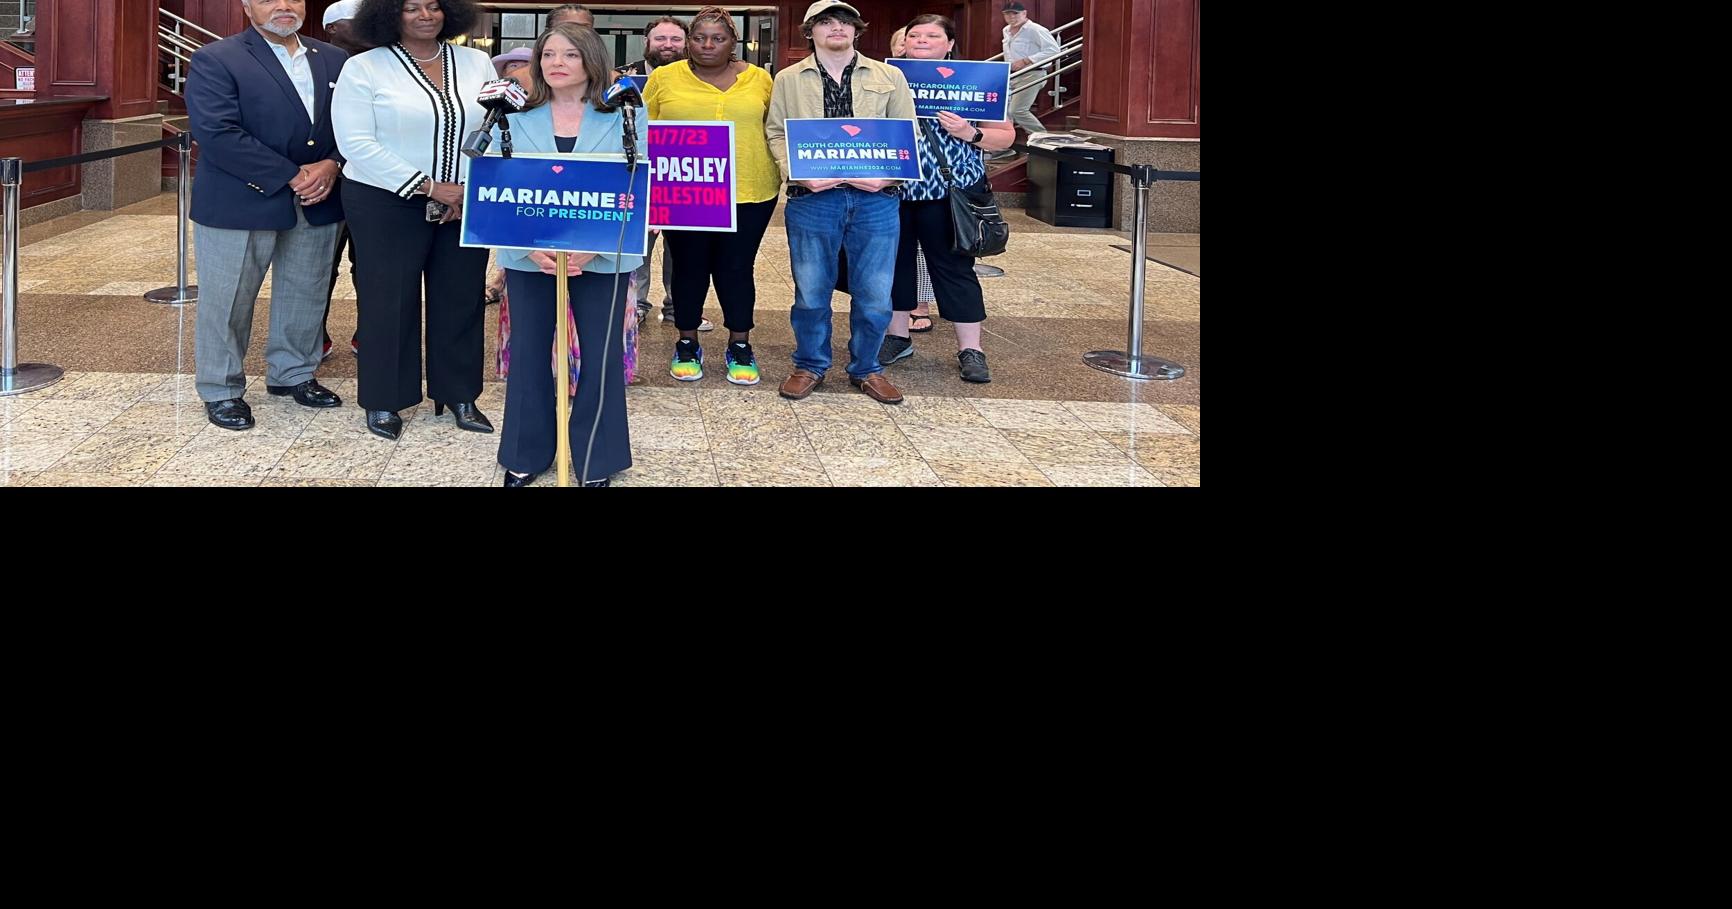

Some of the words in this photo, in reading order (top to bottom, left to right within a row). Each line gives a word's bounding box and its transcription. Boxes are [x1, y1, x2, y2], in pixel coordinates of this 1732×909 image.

[920, 82, 960, 90] CAROLINA
[797, 149, 898, 160] MARIANNE
[478, 186, 616, 208] MARIANNE
[651, 186, 727, 206] RLESTON
[516, 206, 545, 217] FOR
[549, 208, 634, 222] PRESIDENT
